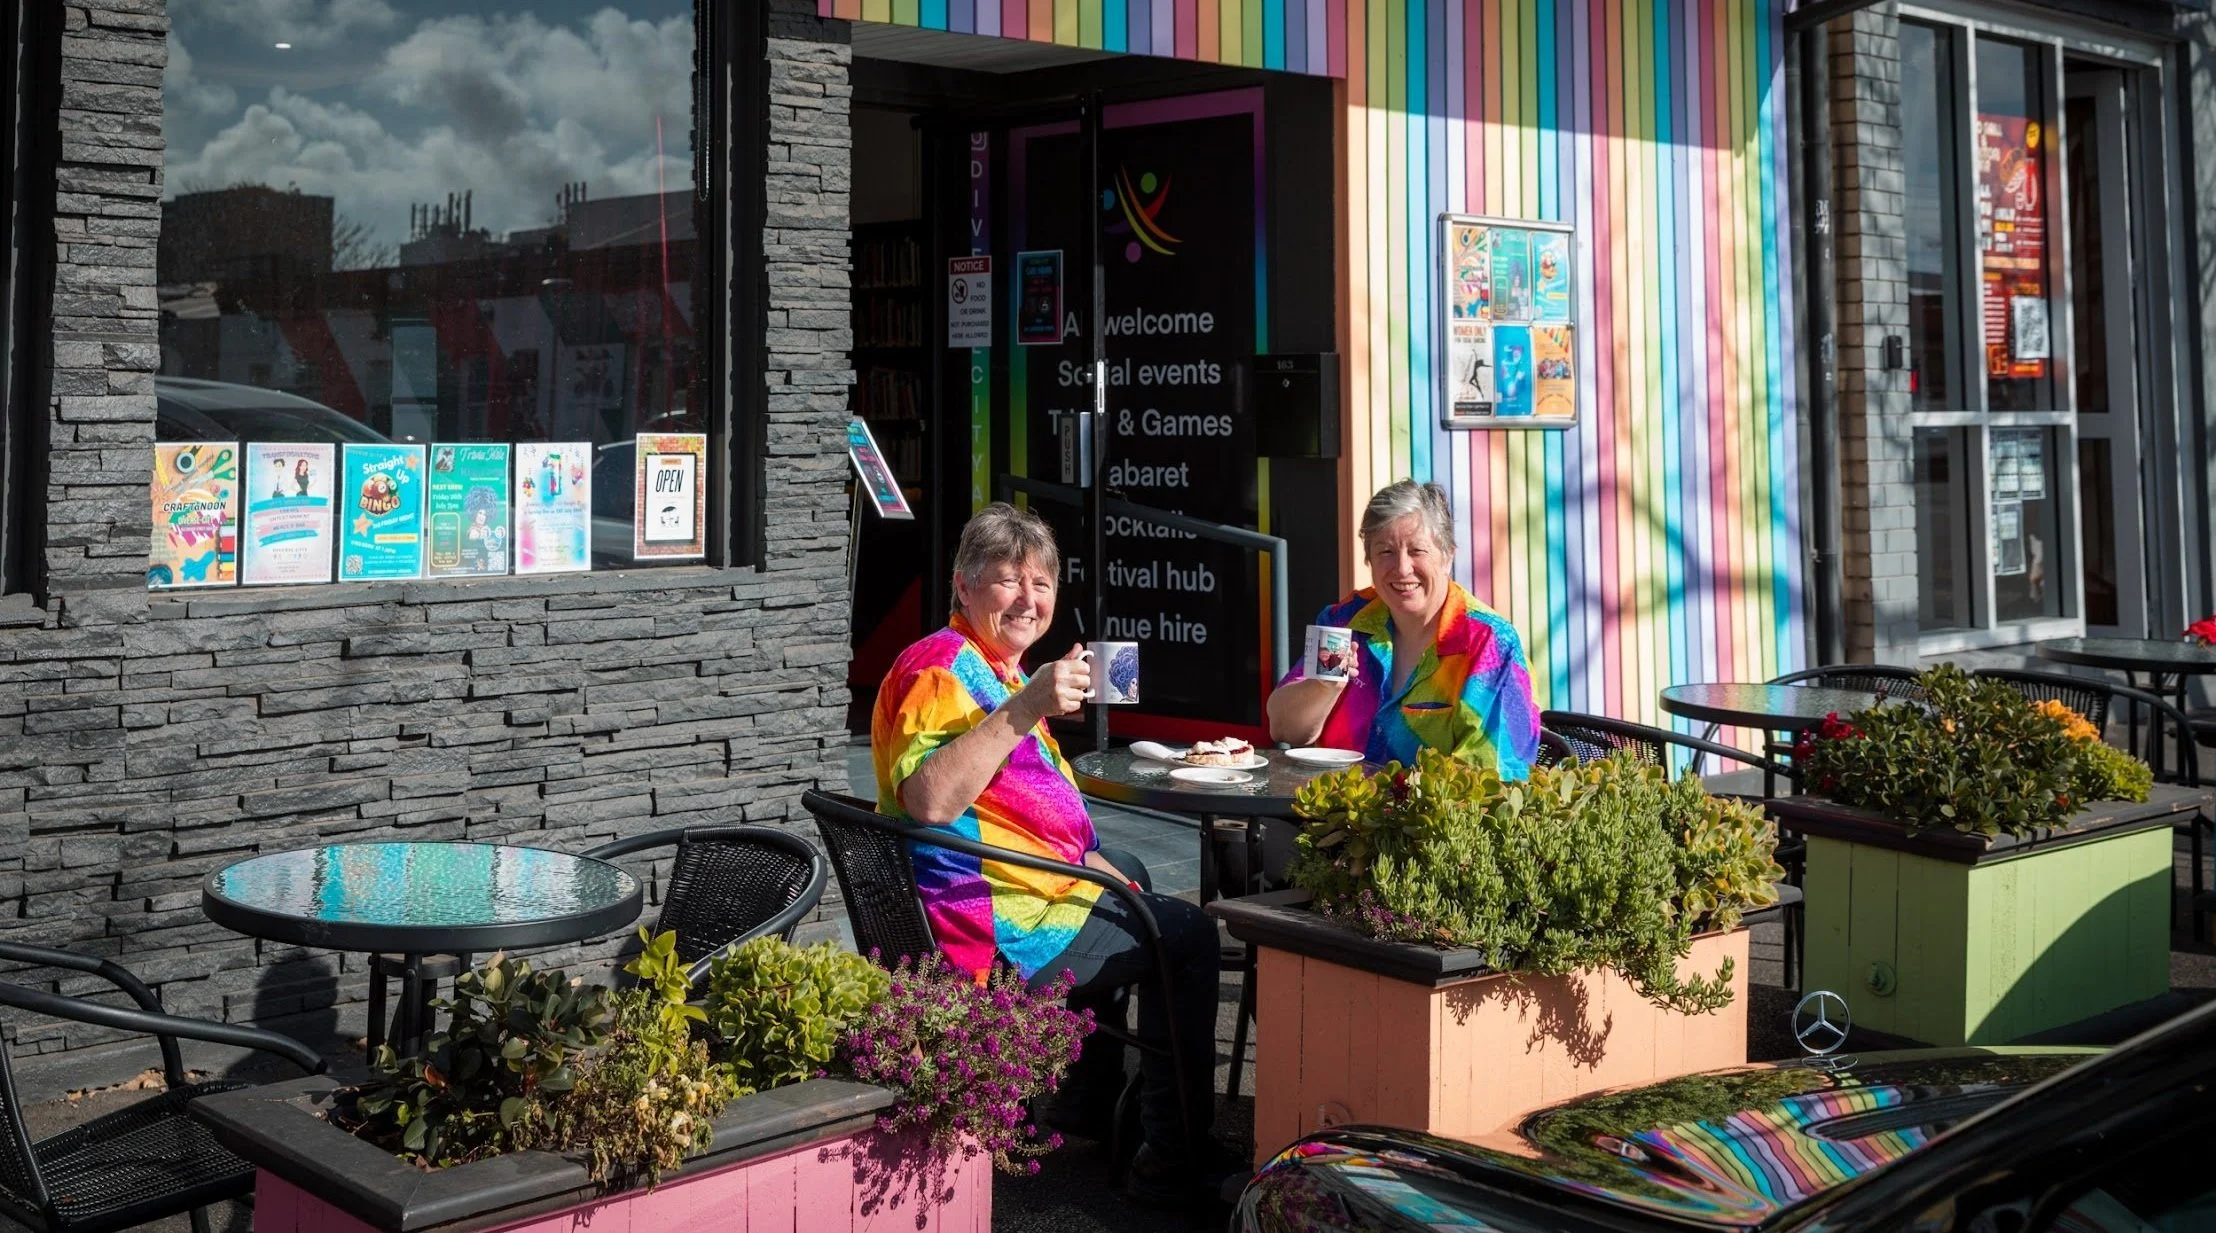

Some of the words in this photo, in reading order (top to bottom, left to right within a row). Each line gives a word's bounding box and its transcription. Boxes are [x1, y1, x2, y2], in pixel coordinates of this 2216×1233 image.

[953, 260, 985, 272] NOTICE
[1104, 307, 1214, 336] welcome
[1058, 358, 1131, 387] Soial
[1138, 359, 1222, 386] events
[1117, 409, 1136, 436] &
[1142, 408, 1233, 437] Games
[362, 455, 404, 475] Straight
[396, 468, 410, 484] Up
[1109, 458, 1190, 488] abaret
[655, 469, 684, 493] OPEN
[360, 495, 401, 511] BINGO
[1082, 510, 1198, 539] ocktail
[1067, 557, 1157, 588] Ftival
[1166, 561, 1215, 592] hub
[1074, 607, 1152, 640] Vnue
[1159, 612, 1207, 644] hire
